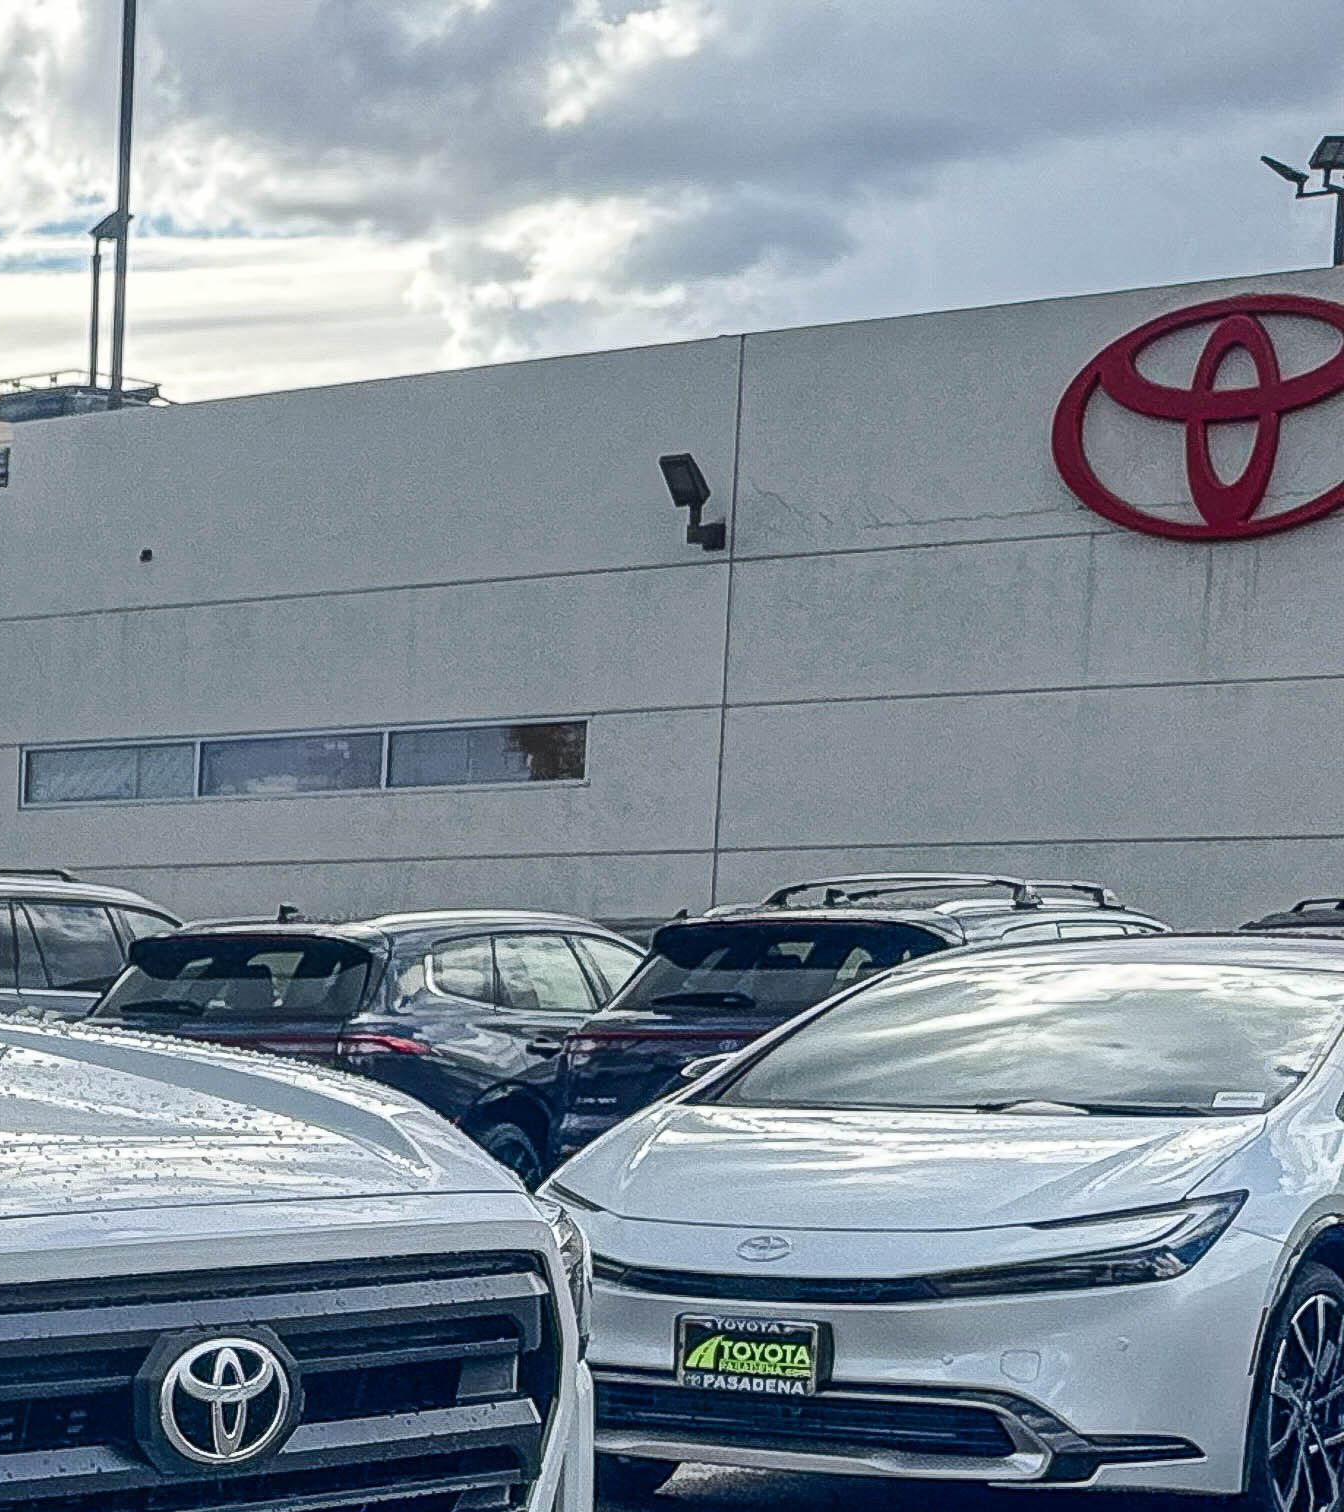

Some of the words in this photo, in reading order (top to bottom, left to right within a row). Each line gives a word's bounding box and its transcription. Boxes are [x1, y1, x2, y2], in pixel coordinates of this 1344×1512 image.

[714, 1317, 780, 1333] TOYOTA
[720, 1341, 810, 1366] TOYOTA
[703, 1375, 805, 1395] PASADENA
